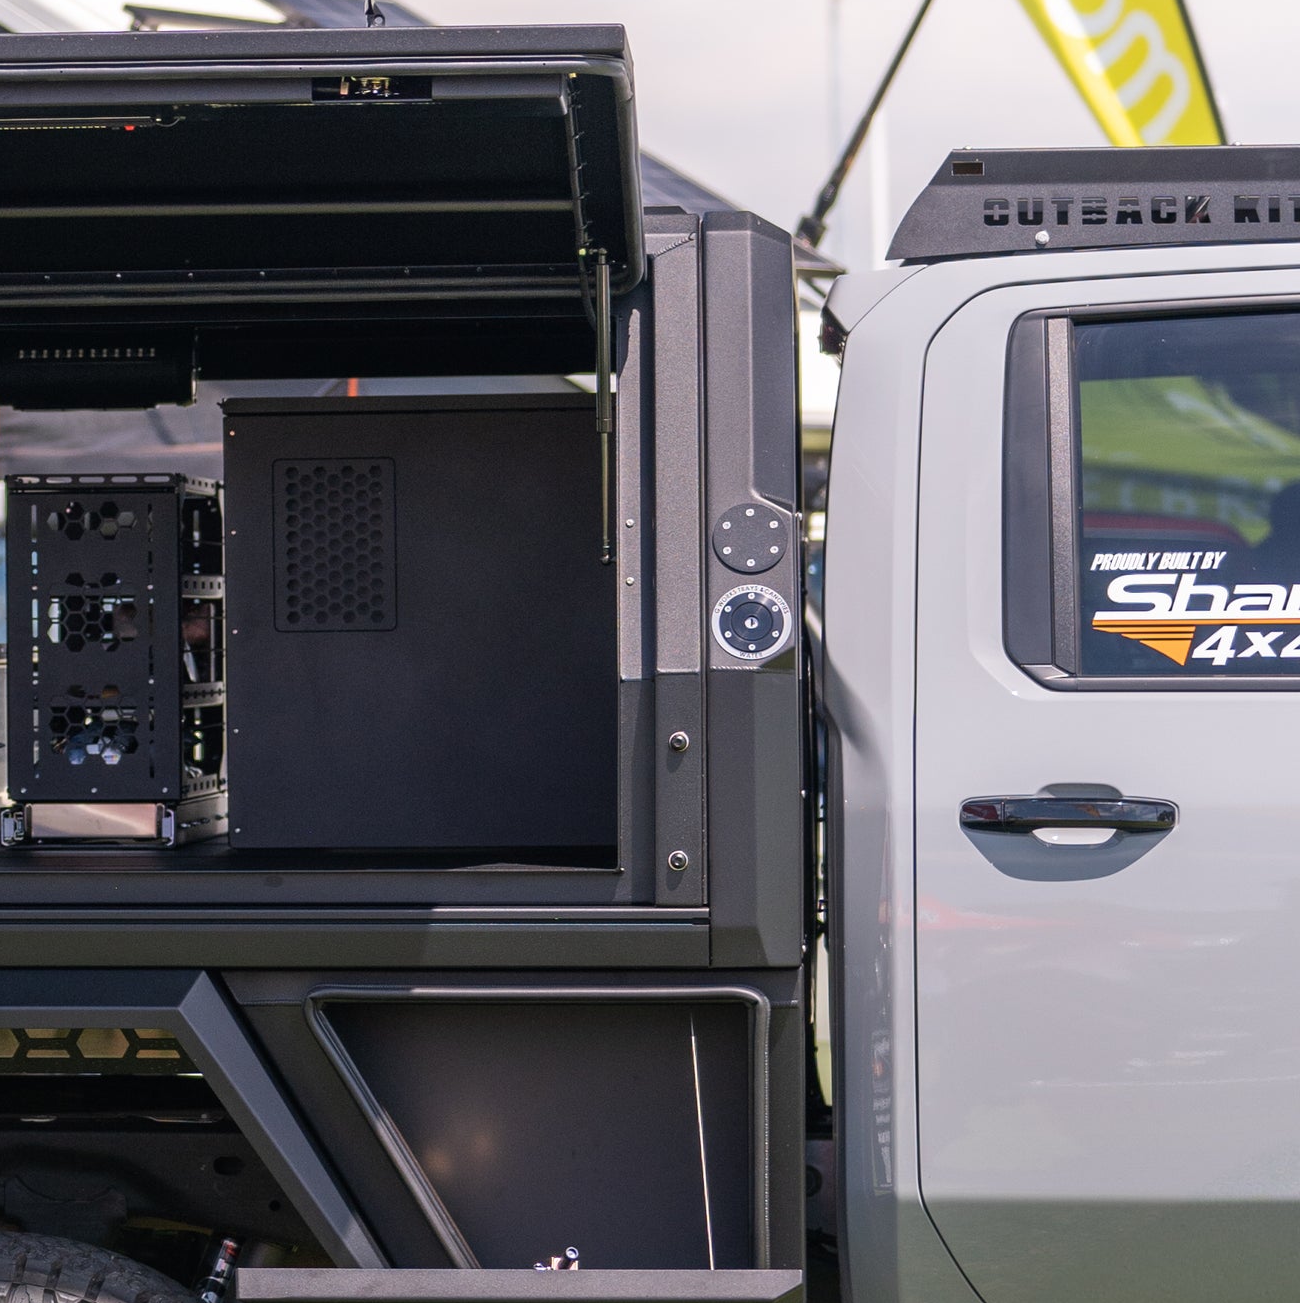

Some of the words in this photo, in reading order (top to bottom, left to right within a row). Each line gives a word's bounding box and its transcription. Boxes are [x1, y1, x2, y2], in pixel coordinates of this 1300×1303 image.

[983, 195, 1212, 226] OUTBACK
[1090, 552, 1161, 571] PROUDLY
[1157, 552, 1203, 570] BUILT
[1200, 551, 1227, 570] BY
[719, 589, 738, 607] WORKS
[738, 585, 759, 593] TRAYS
[739, 651, 764, 659] WATER
